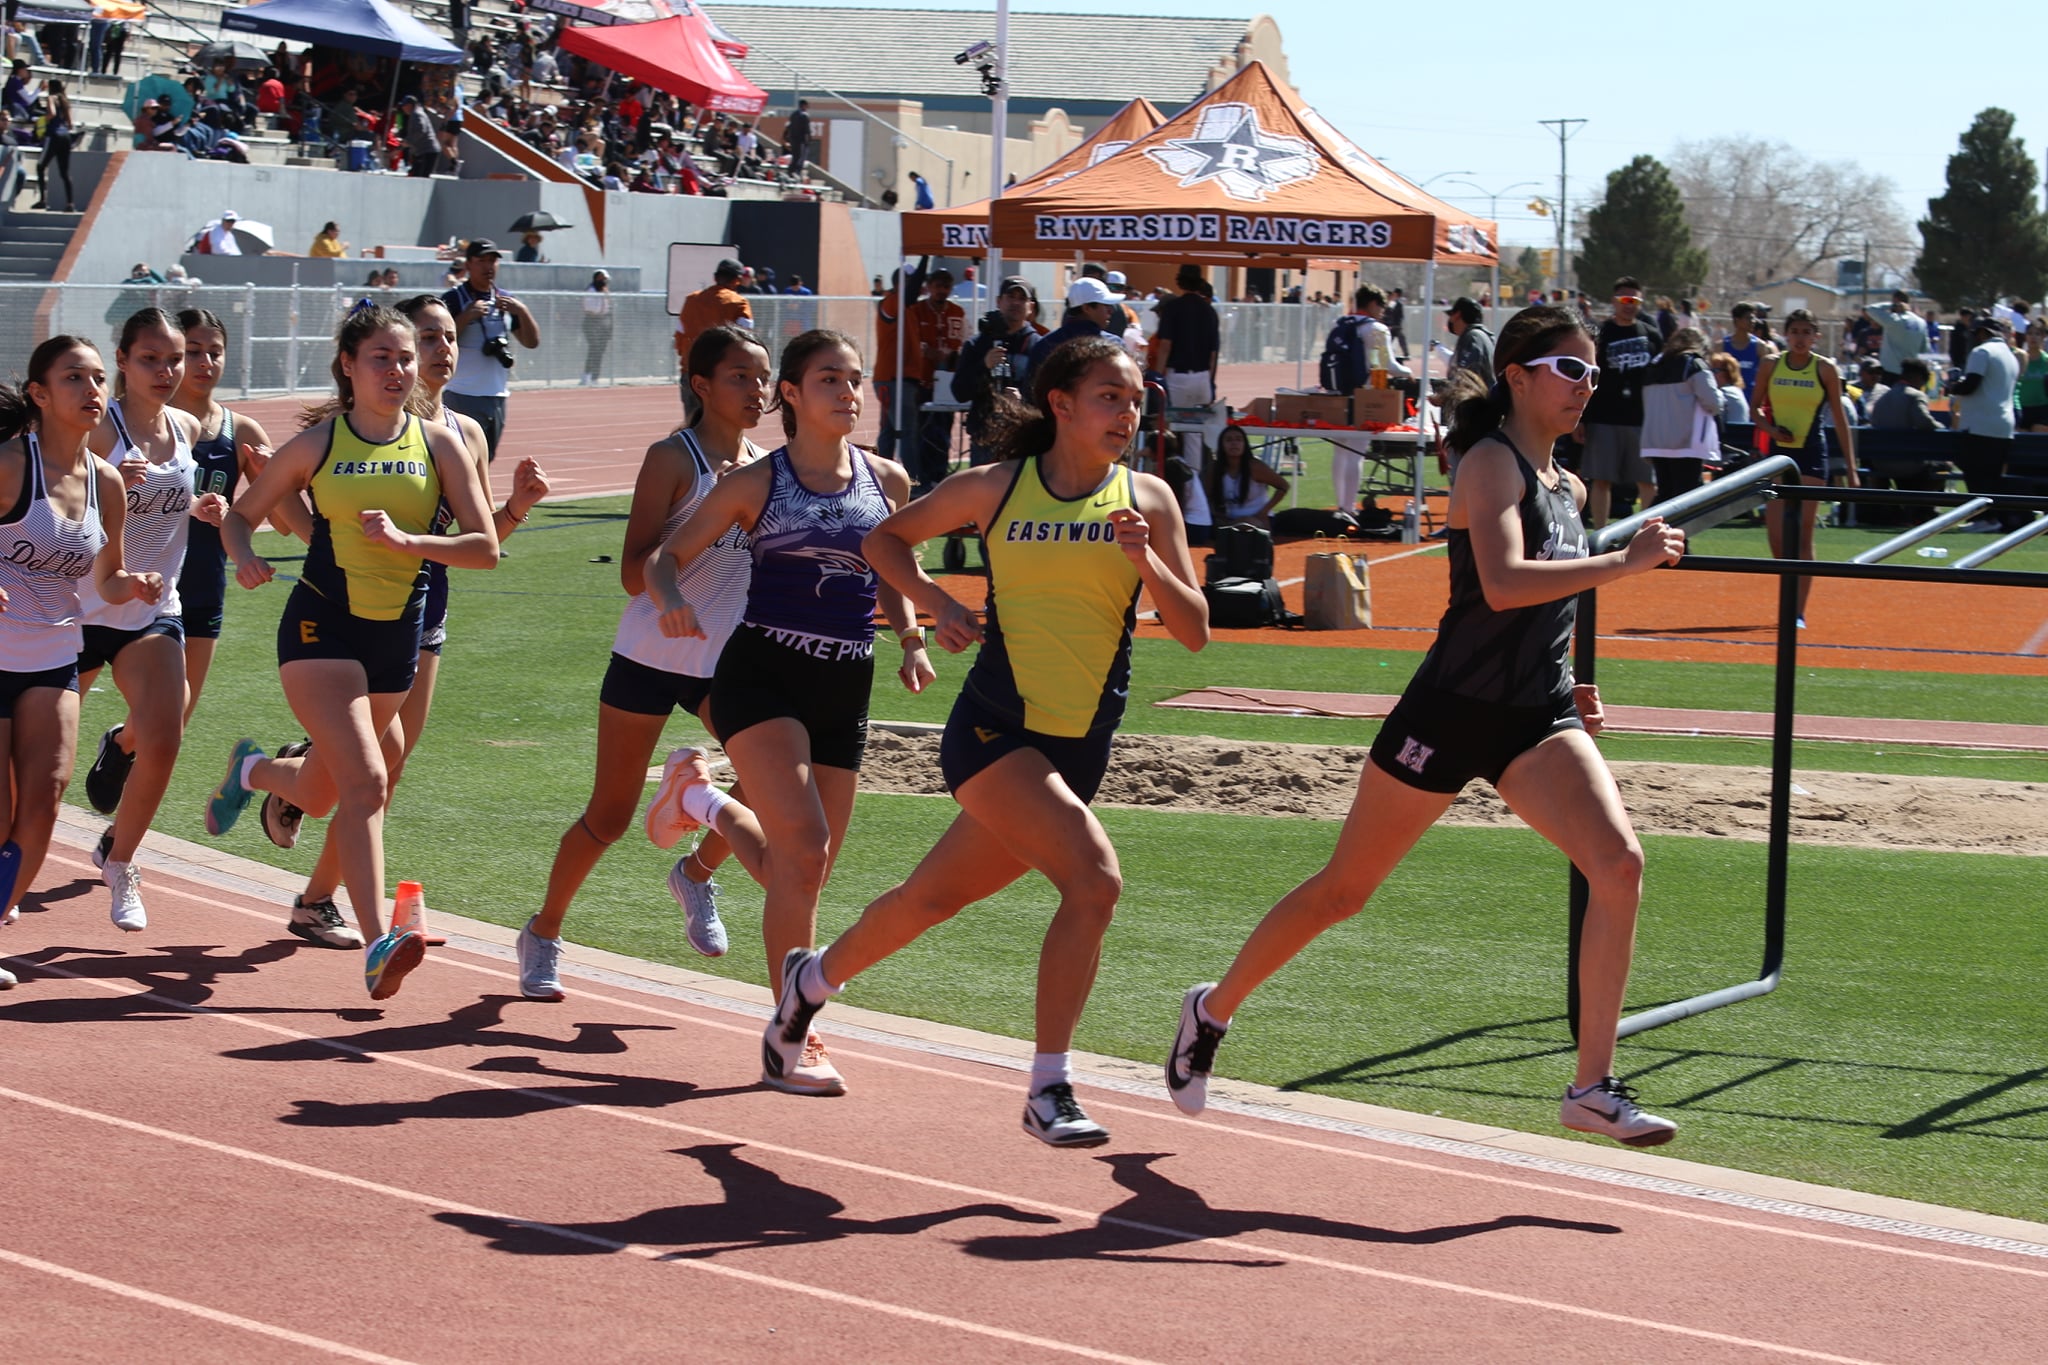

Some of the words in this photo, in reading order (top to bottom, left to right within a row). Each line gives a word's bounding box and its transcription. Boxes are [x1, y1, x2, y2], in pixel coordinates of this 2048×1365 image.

[1037, 215, 1218, 240] RIVERSIDE
[1227, 217, 1391, 247] RANGERS
[332, 461, 428, 477] EASTWOOD
[1006, 520, 1121, 544] EASTWOO
[300, 620, 321, 644] E
[763, 627, 835, 660] NIKE
